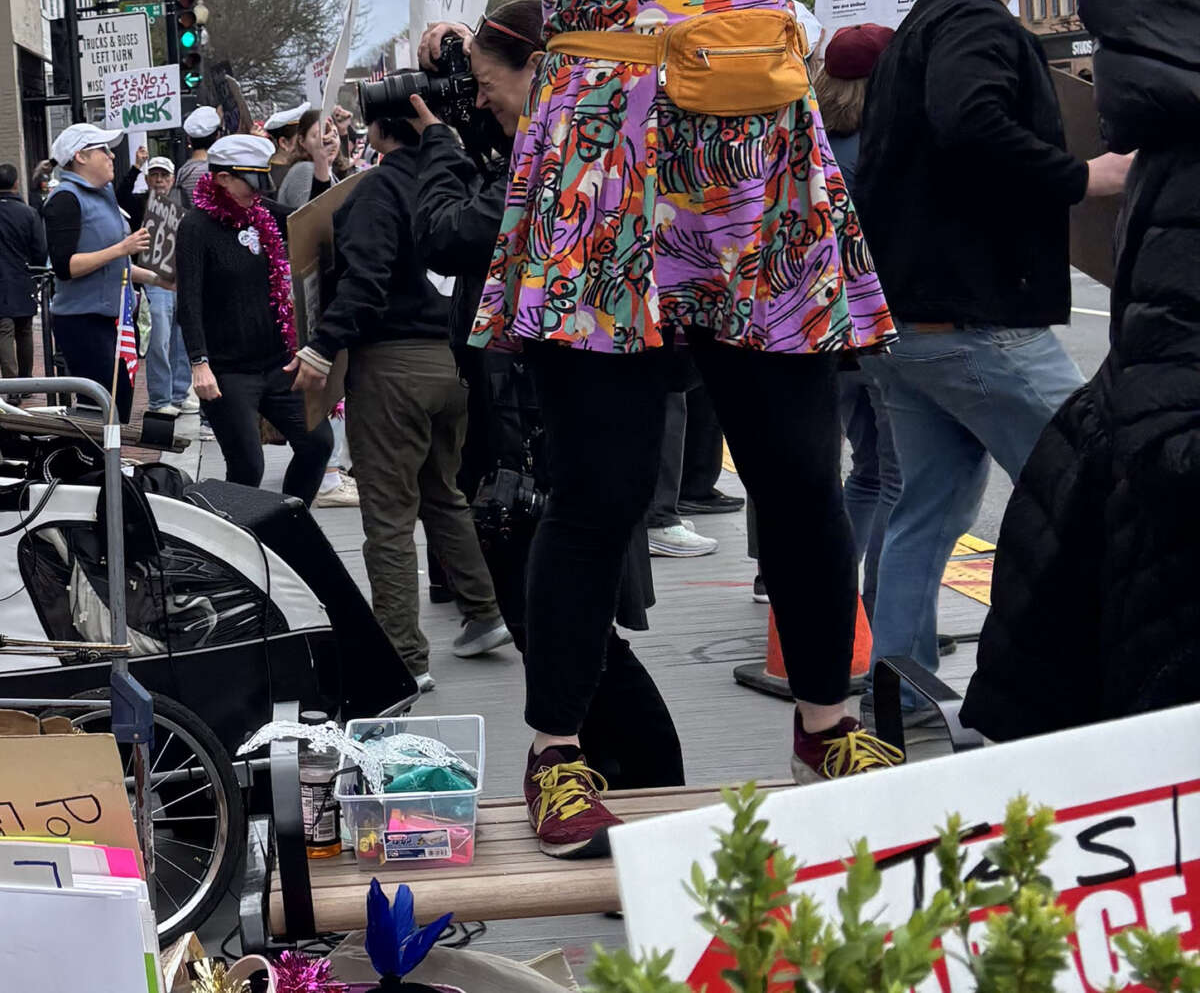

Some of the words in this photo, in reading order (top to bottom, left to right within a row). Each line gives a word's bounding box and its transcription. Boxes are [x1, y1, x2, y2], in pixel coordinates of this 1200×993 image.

[83, 37, 108, 50] TRUCKS
[110, 36, 116, 48] &
[117, 33, 138, 47] BUSES
[91, 50, 110, 64] LEFT
[112, 48, 133, 62] TURN
[129, 83, 176, 103] SMELL
[122, 97, 172, 128] MUSK
